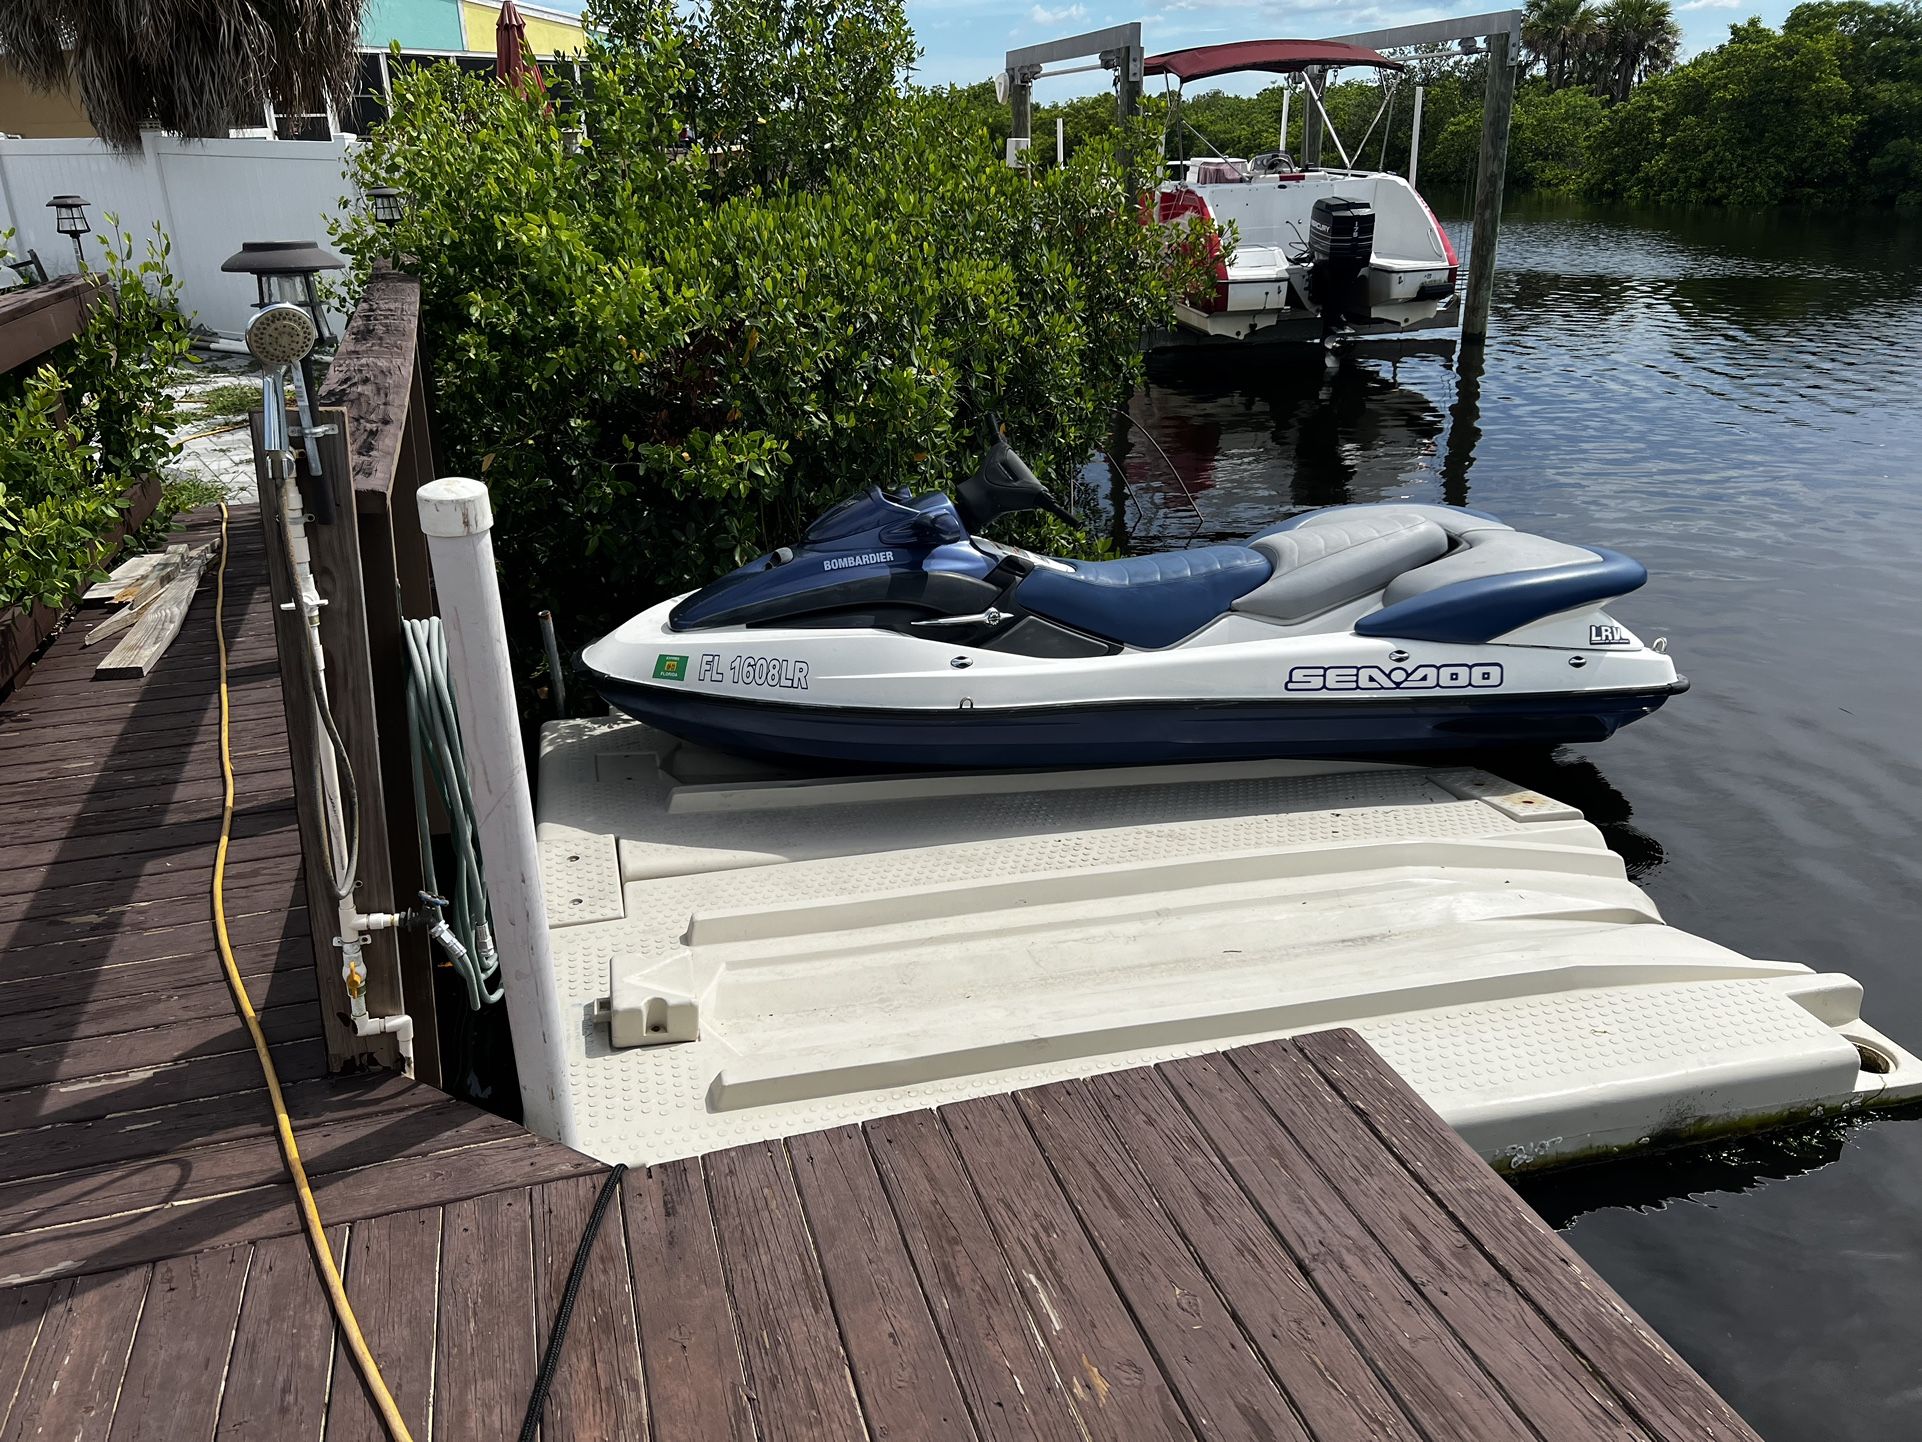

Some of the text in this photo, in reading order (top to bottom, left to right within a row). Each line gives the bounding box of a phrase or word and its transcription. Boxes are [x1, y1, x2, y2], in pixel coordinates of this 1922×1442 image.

[823, 551, 894, 571] BOMBARDIER
[698, 654, 809, 689] FL 1608LR
